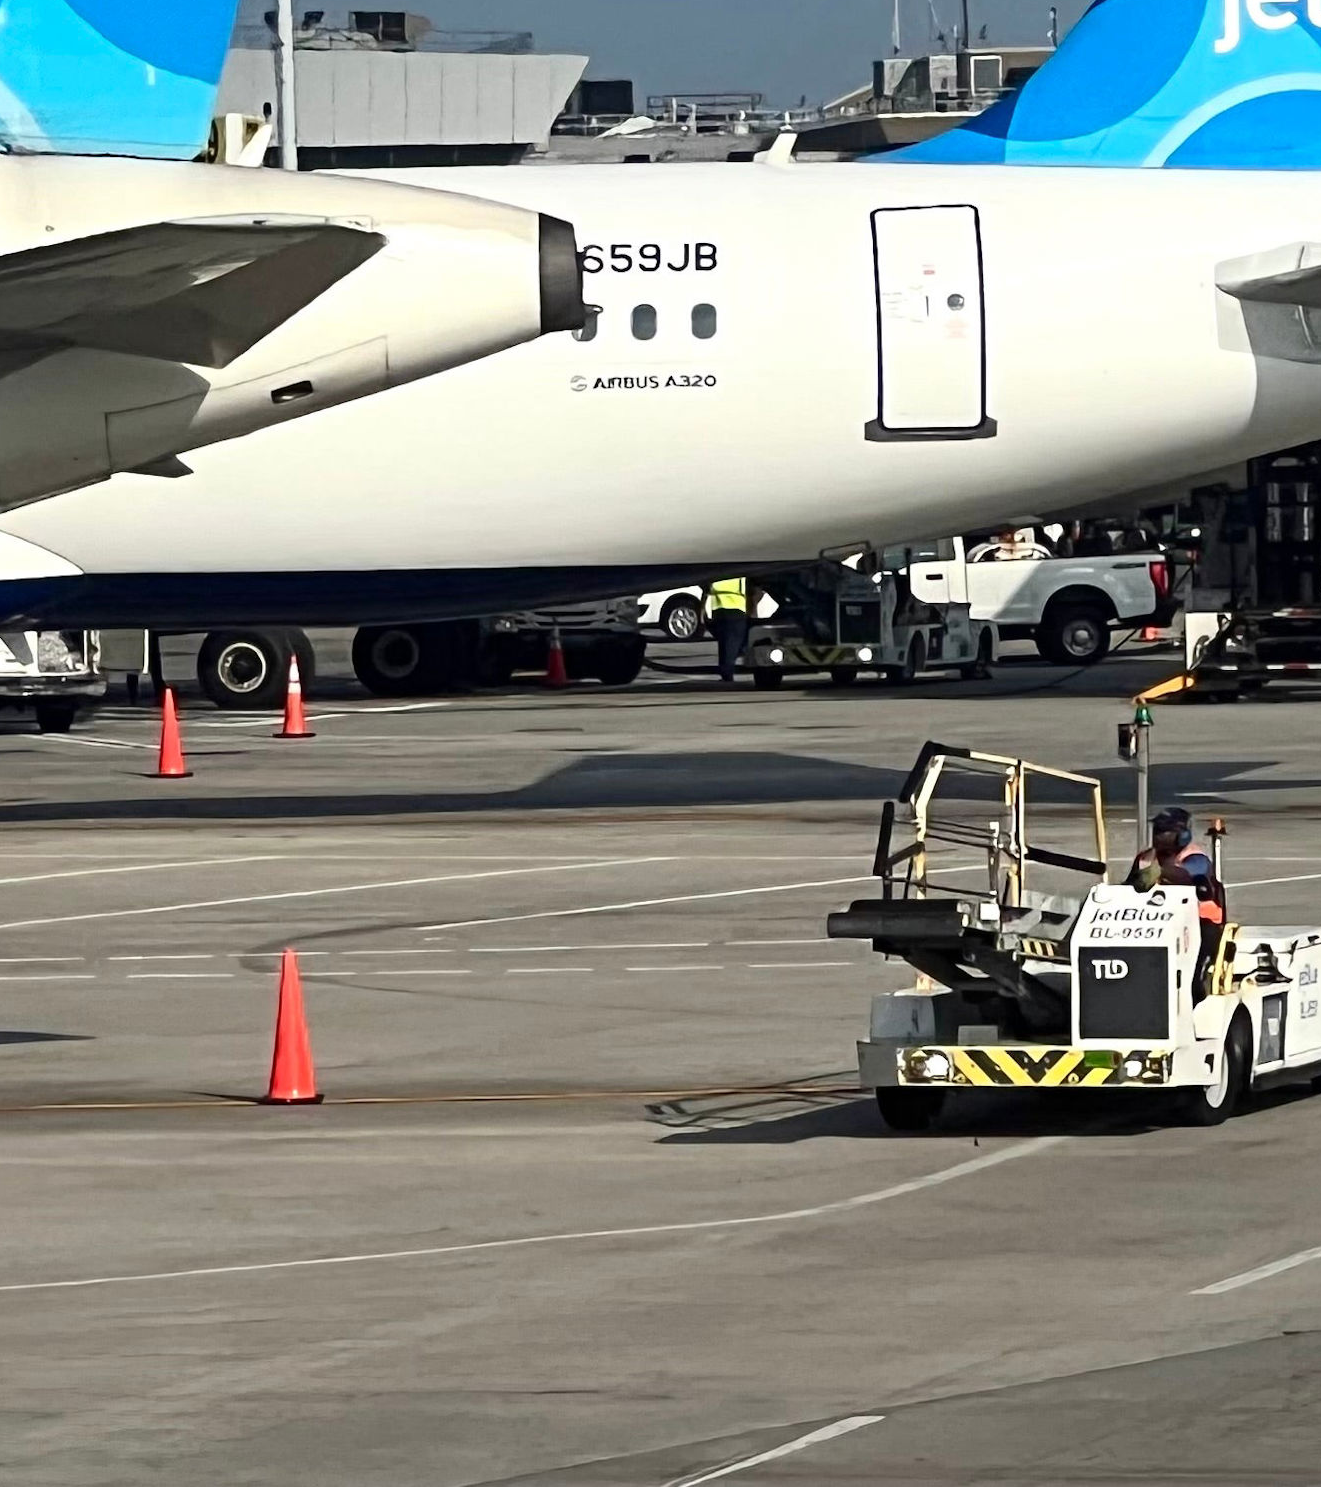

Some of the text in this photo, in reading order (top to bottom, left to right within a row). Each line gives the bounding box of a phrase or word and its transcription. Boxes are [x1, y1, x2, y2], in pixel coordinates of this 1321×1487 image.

[592, 373, 717, 390] AIRBUS A320
[1091, 959, 1129, 980] TLD
